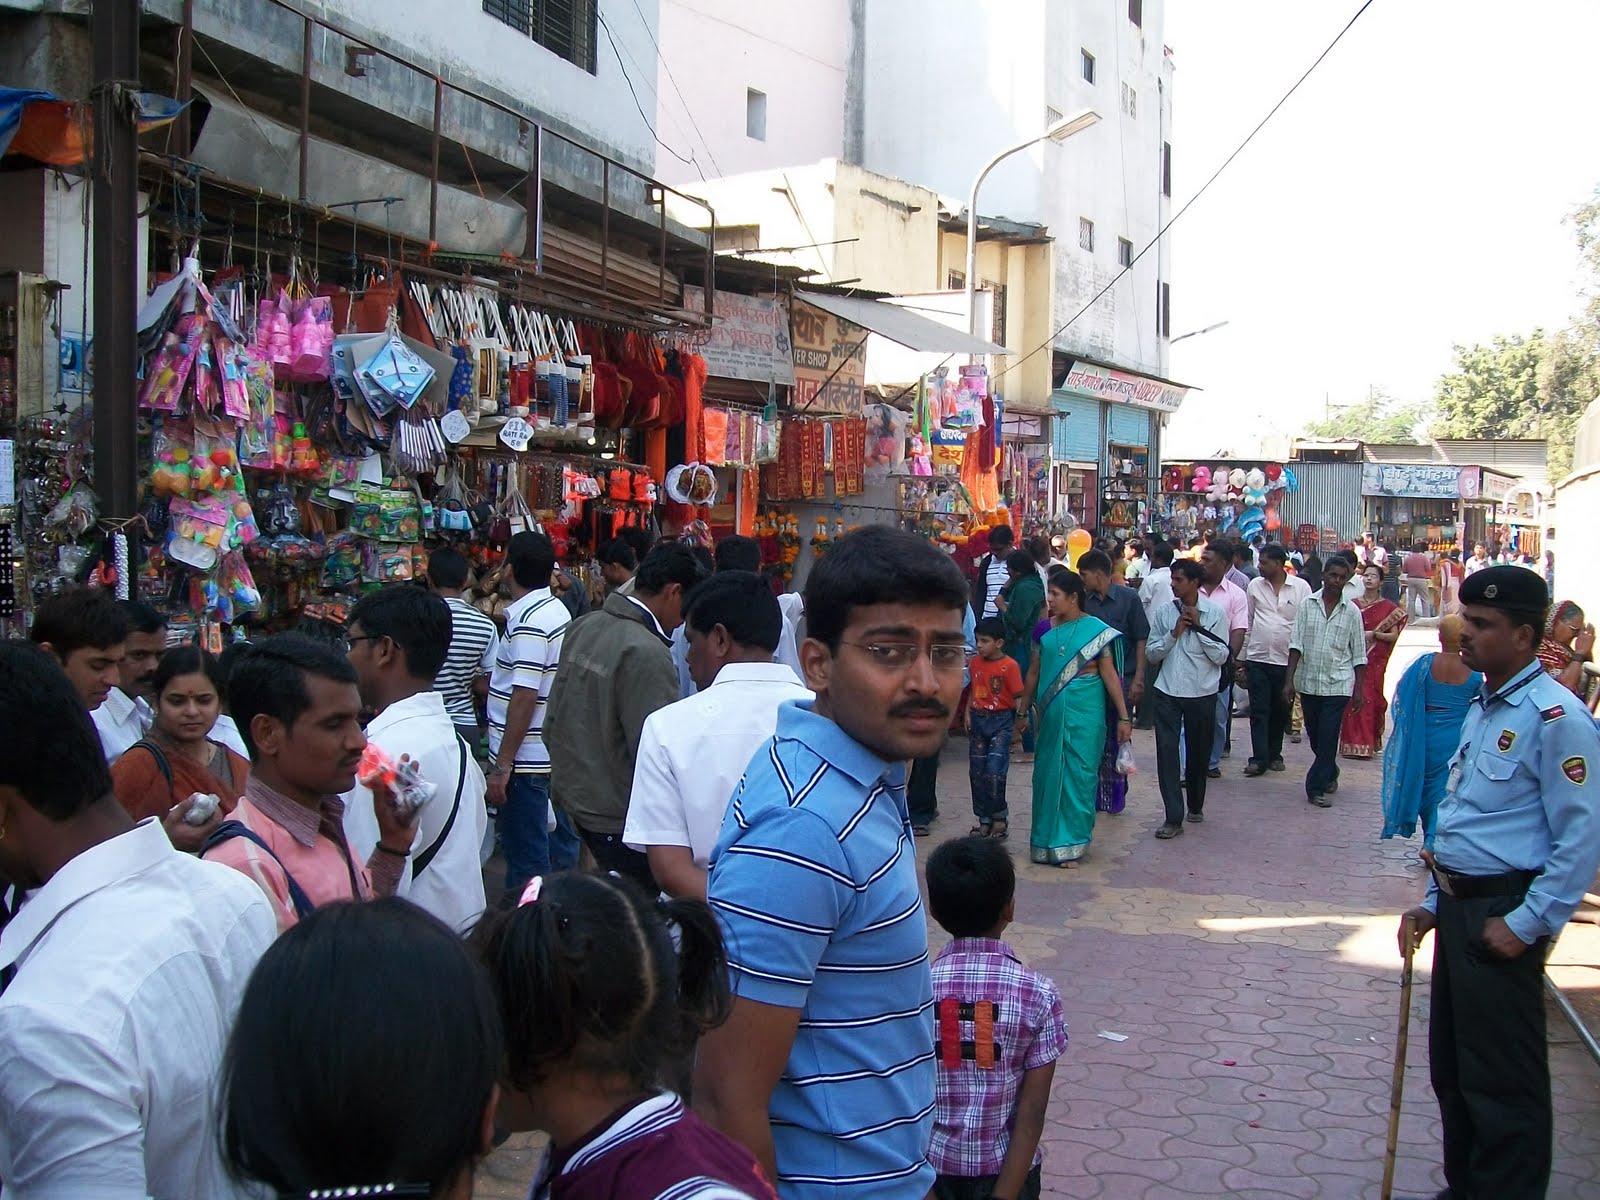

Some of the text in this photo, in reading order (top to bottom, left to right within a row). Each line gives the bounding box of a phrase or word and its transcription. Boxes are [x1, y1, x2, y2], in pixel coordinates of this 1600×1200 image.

[807, 351, 828, 367] SHOP
[509, 421, 526, 432] FIX
[503, 430, 517, 438] RATE
